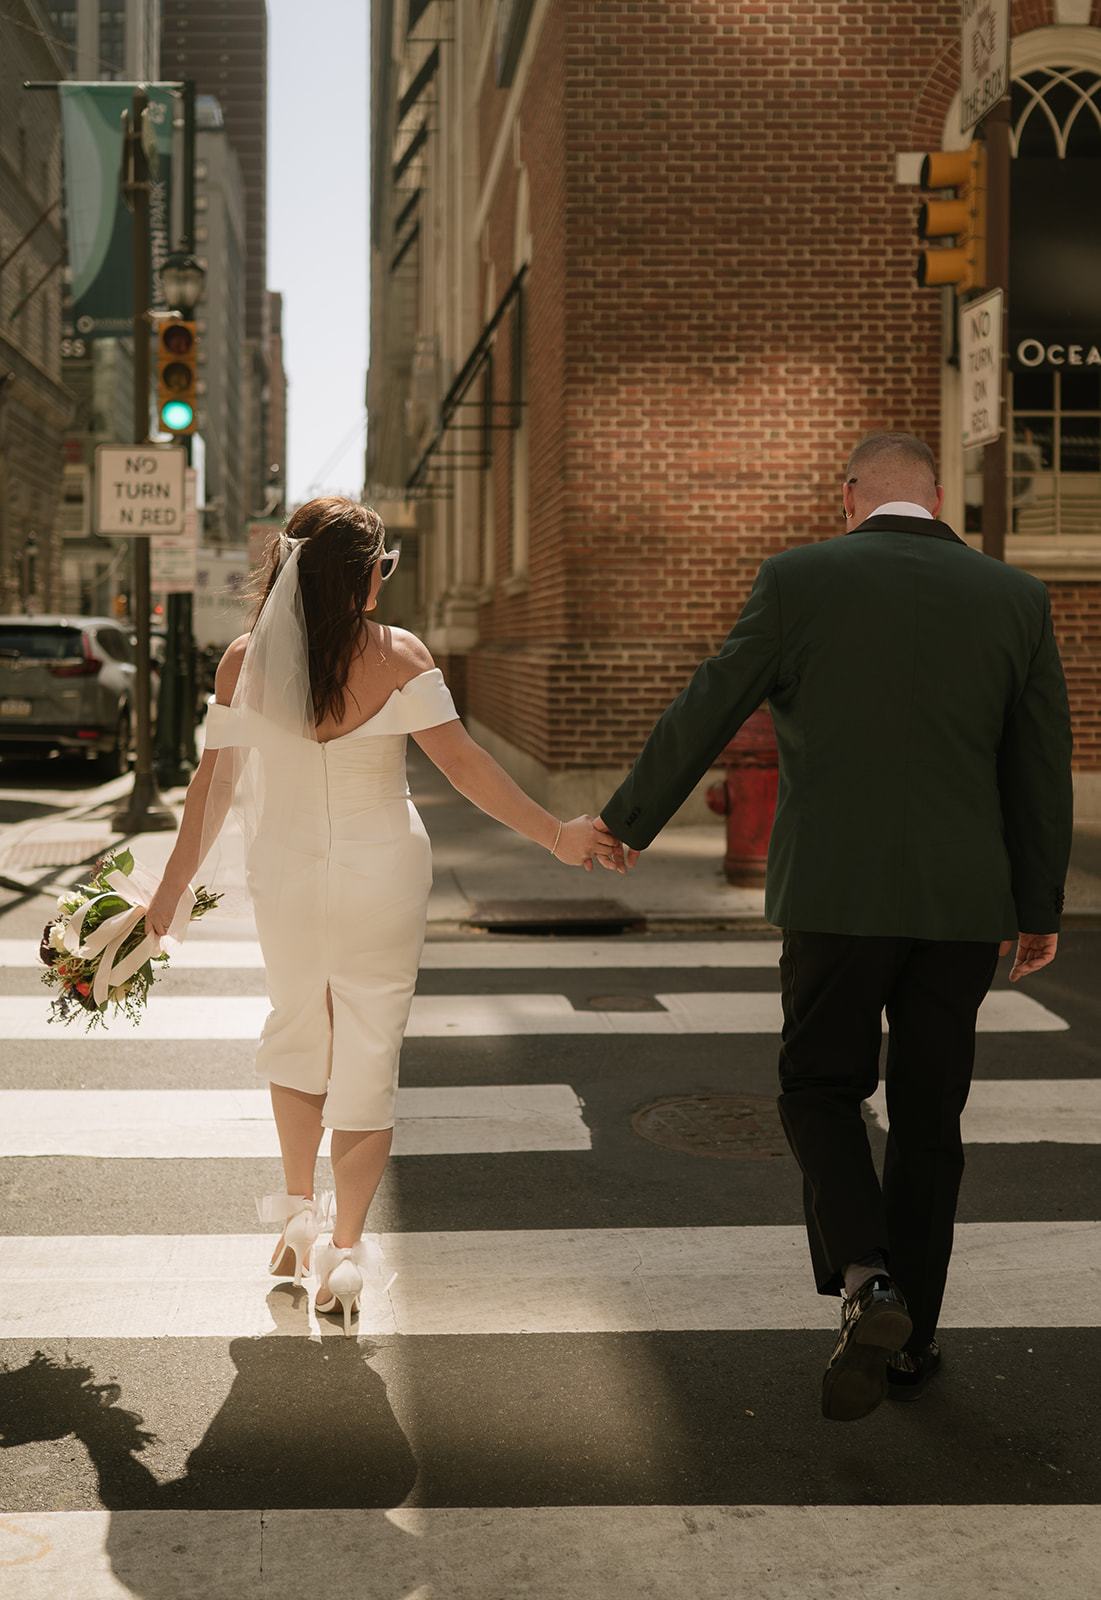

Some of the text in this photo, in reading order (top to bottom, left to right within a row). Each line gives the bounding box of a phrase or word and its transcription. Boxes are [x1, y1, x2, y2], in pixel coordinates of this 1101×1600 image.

[149, 181, 168, 229] PARK
[971, 311, 991, 341] NO
[968, 347, 994, 372] TURN
[974, 380, 988, 402] ON
[971, 408, 988, 432] RED
[125, 456, 157, 474] NO
[113, 481, 170, 499] TURN
[140, 506, 176, 526] RED
